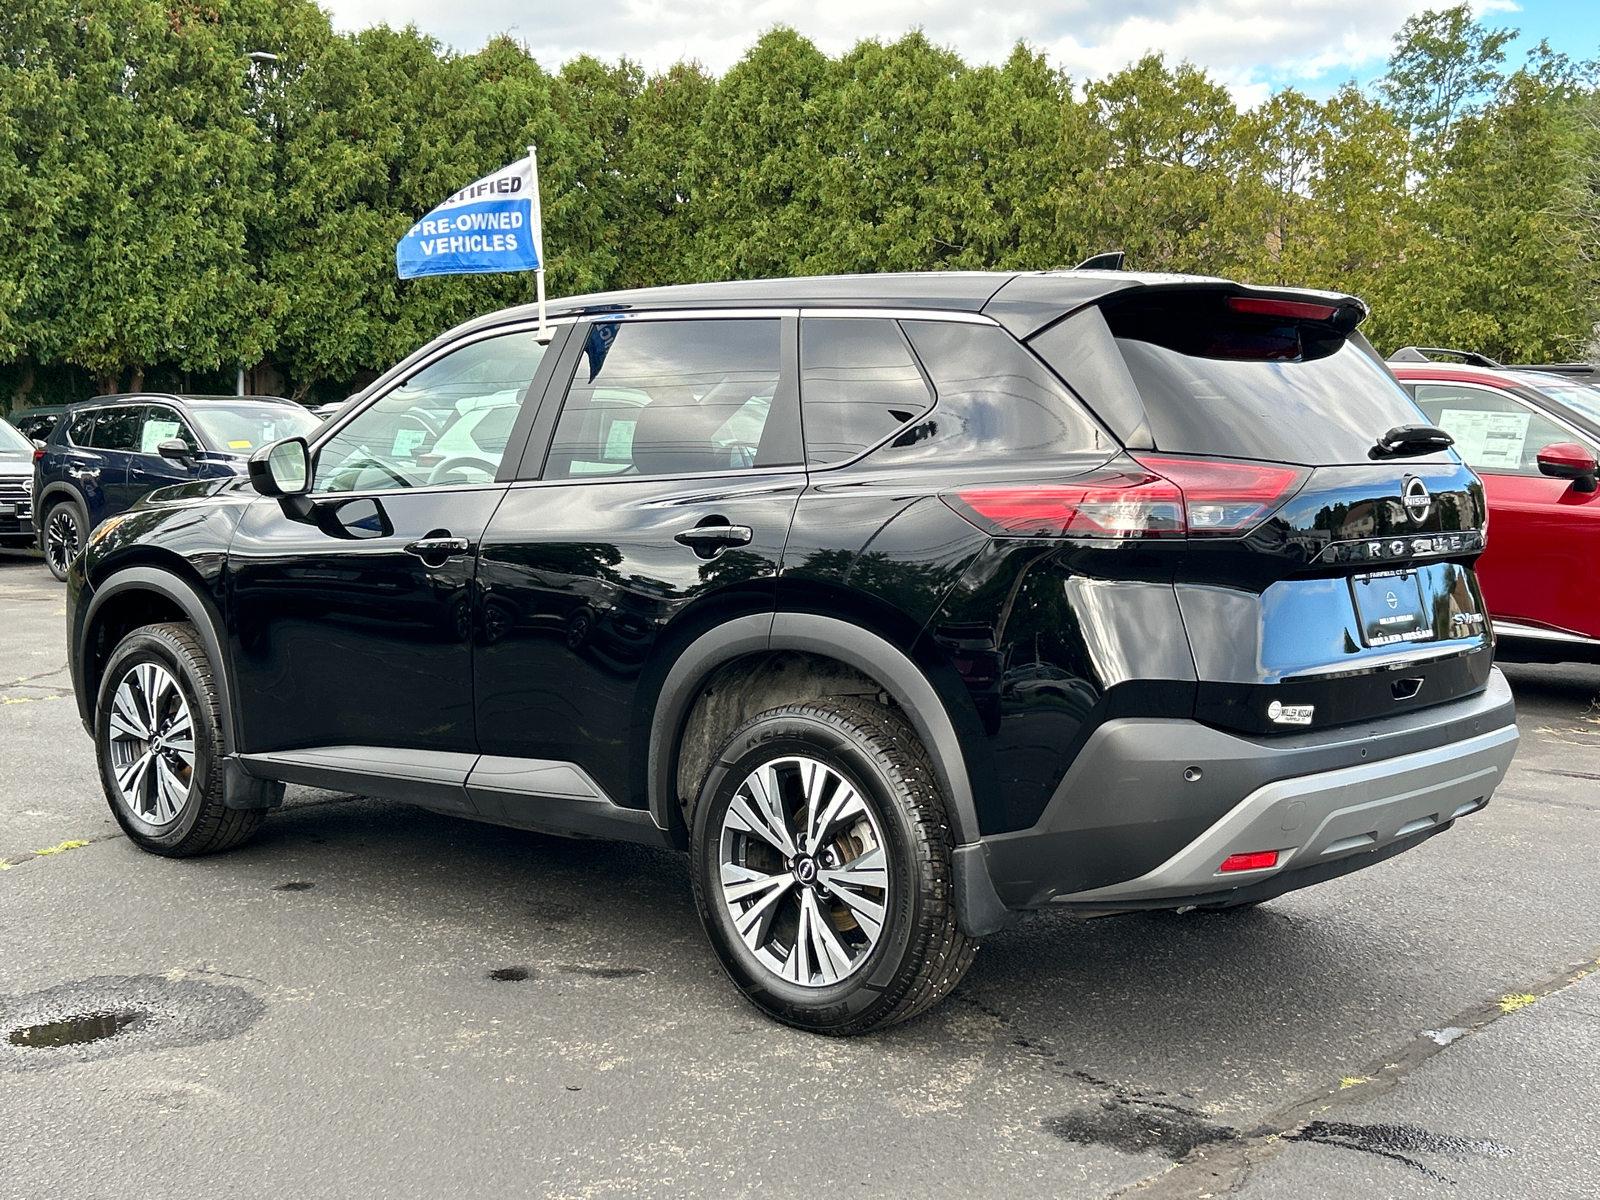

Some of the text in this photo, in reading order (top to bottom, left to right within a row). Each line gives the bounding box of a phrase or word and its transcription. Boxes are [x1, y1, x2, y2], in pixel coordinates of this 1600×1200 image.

[408, 212, 523, 237] PRE-OWNED
[420, 235, 518, 255] VEHICLES
[1405, 497, 1431, 505] NISSAN
[1367, 536, 1461, 557] ROGUE
[1369, 629, 1434, 647] MILLER NISSAN
[1281, 708, 1312, 718] MILLER NISSAN
[746, 724, 812, 749] KELLY
[898, 855, 910, 925] TOURING
[781, 1002, 849, 1023] KELLY
